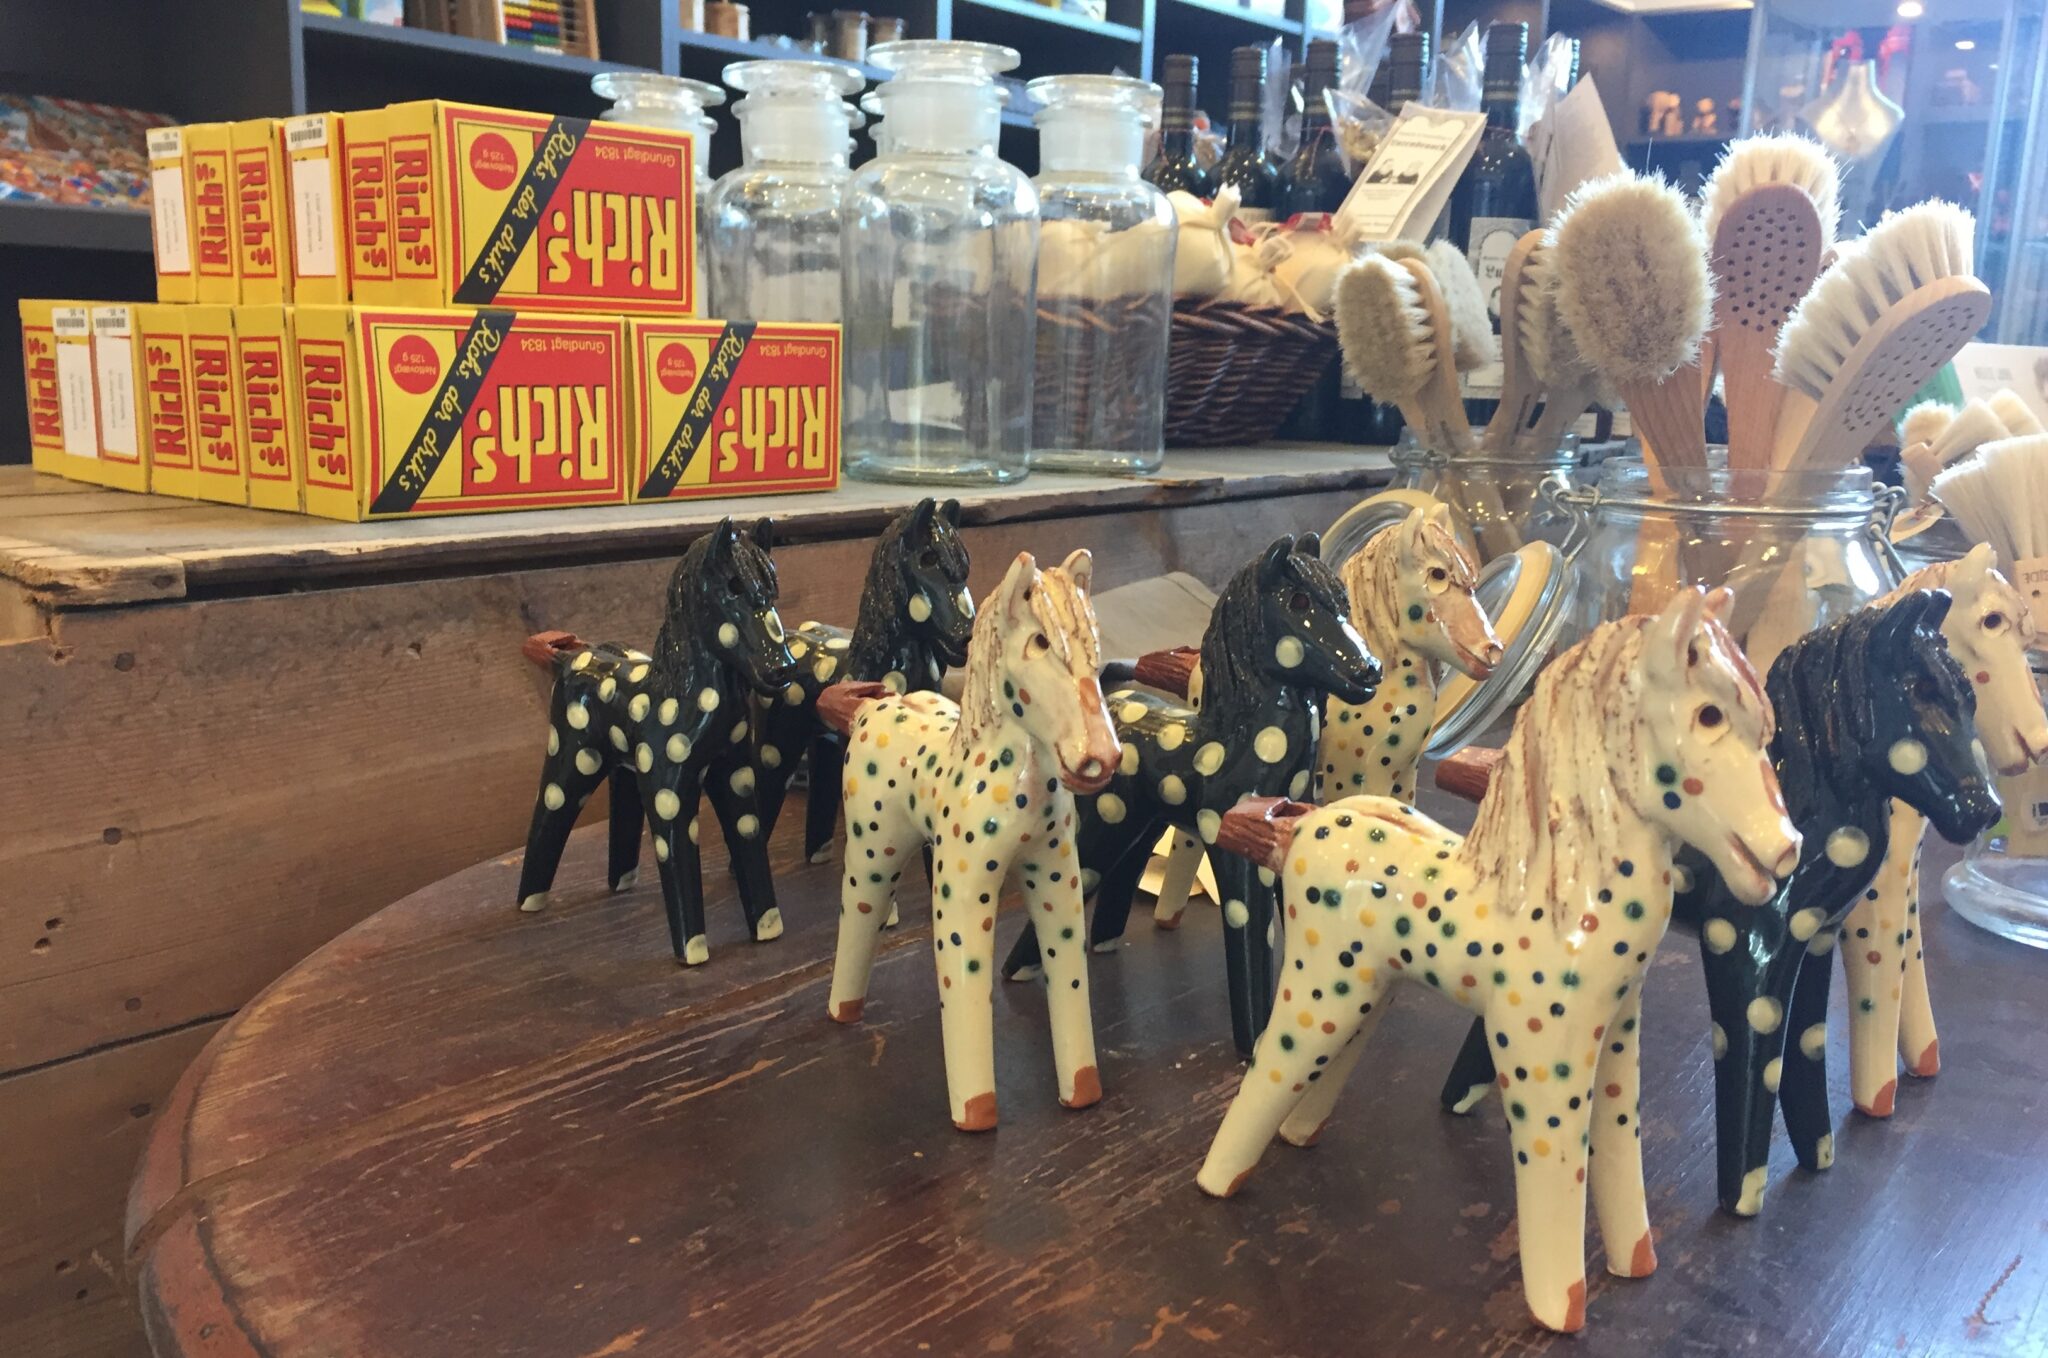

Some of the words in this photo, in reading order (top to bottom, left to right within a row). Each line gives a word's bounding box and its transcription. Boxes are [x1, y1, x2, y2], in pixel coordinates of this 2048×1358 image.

[489, 152, 504, 161] 125
[594, 146, 622, 160] 1834
[623, 149, 676, 168] Grundlagt
[511, 185, 539, 220] der
[520, 338, 547, 352] 1834
[550, 339, 606, 355] Grundlagt
[759, 345, 782, 358] 1834
[783, 343, 827, 359] Grundlagt
[411, 354, 425, 363] 125
[434, 385, 463, 422] der
[690, 386, 713, 419] der
